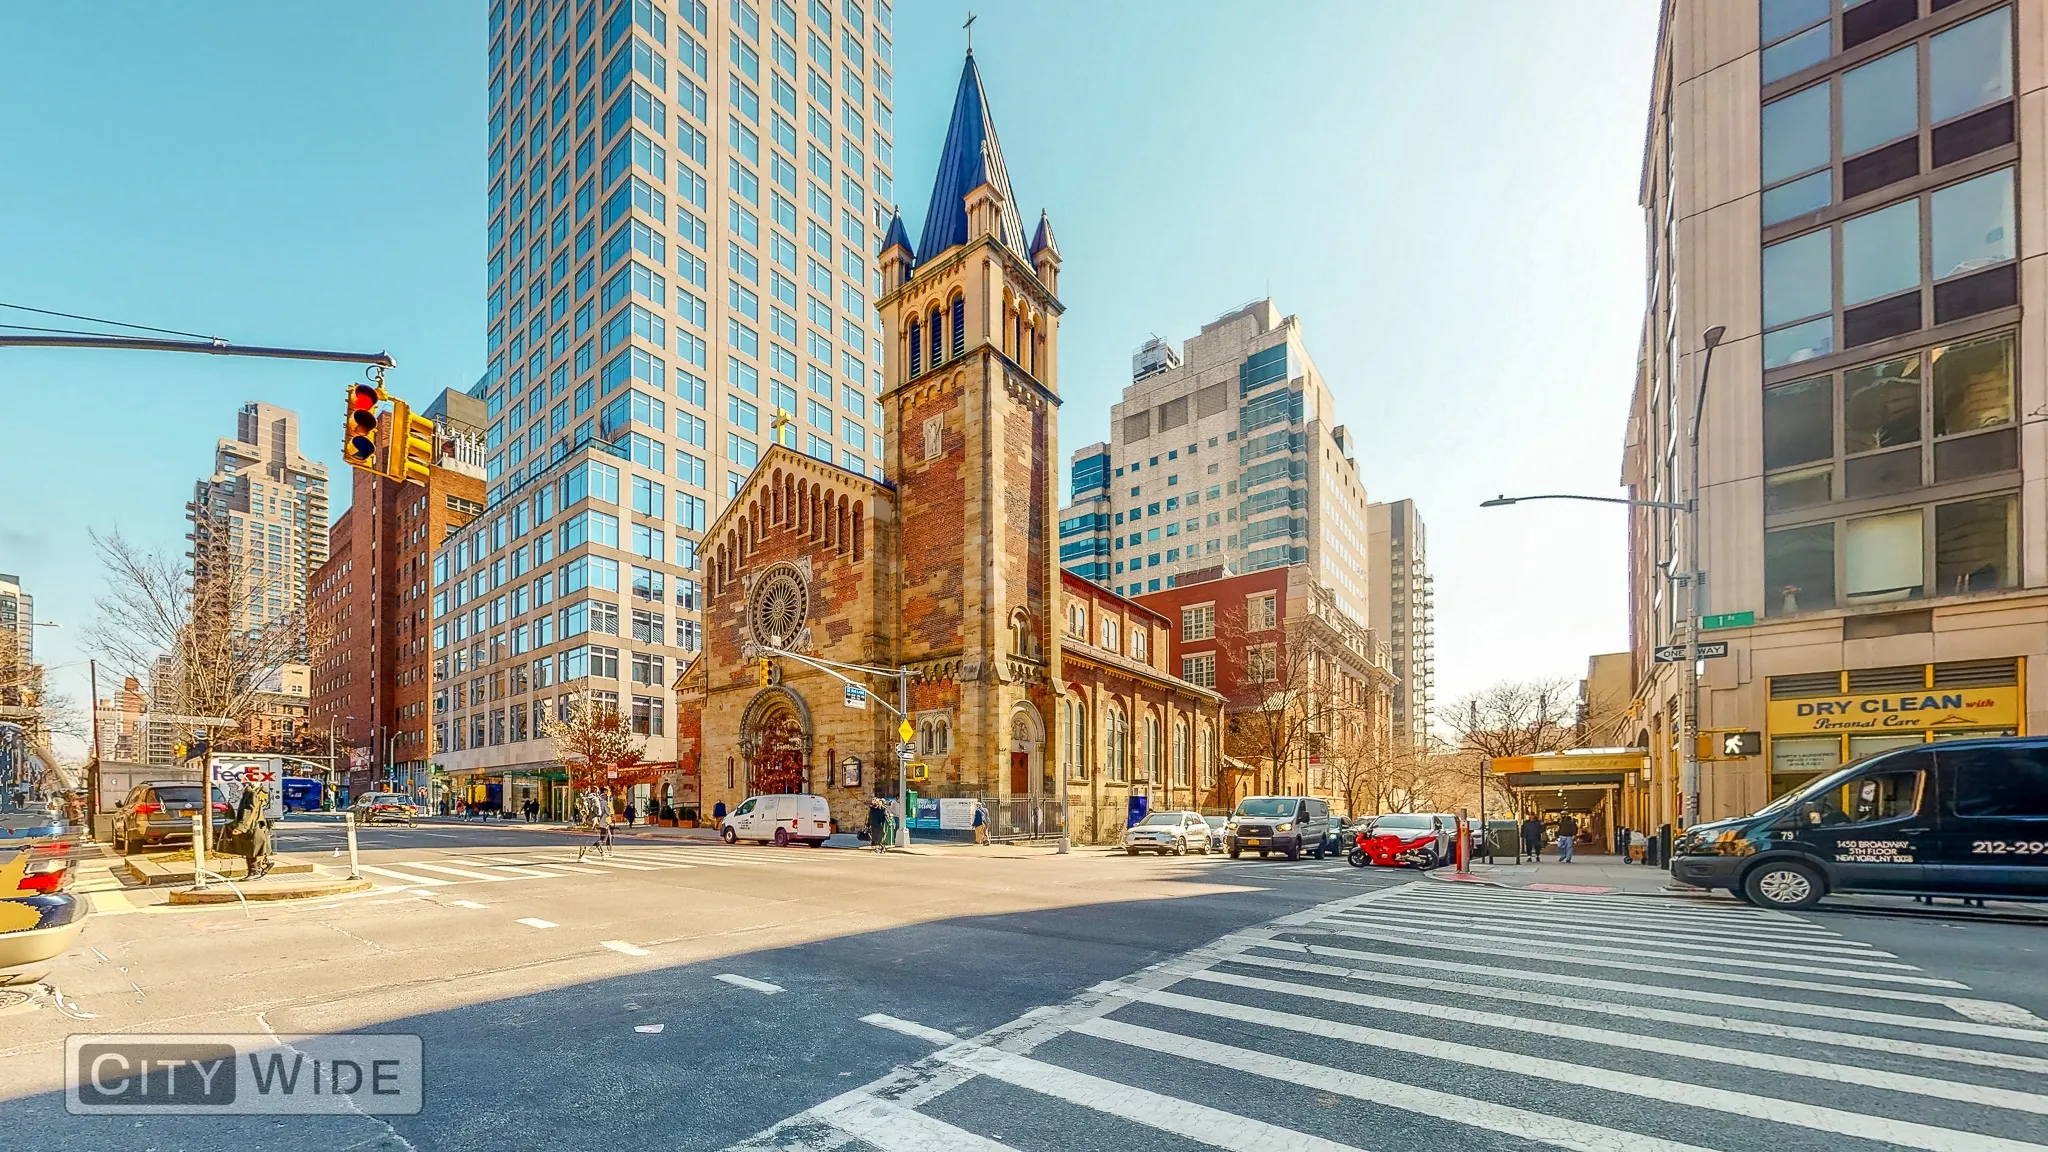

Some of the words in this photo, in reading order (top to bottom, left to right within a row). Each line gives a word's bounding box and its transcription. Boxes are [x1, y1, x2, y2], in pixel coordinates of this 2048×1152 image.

[1718, 616, 1724, 627] 1
[1663, 650, 1685, 658] ONE
[1797, 701, 1852, 716] DRY
[1860, 694, 1962, 713] CLEAN
[1965, 699, 1995, 708] with
[1812, 718, 1877, 730] Personal
[1882, 714, 1921, 727] Care
[213, 765, 276, 783] FedEx
[1781, 831, 1794, 840] 79
[1836, 840, 1857, 848] 1450
[1859, 840, 1909, 849] BROADWAY
